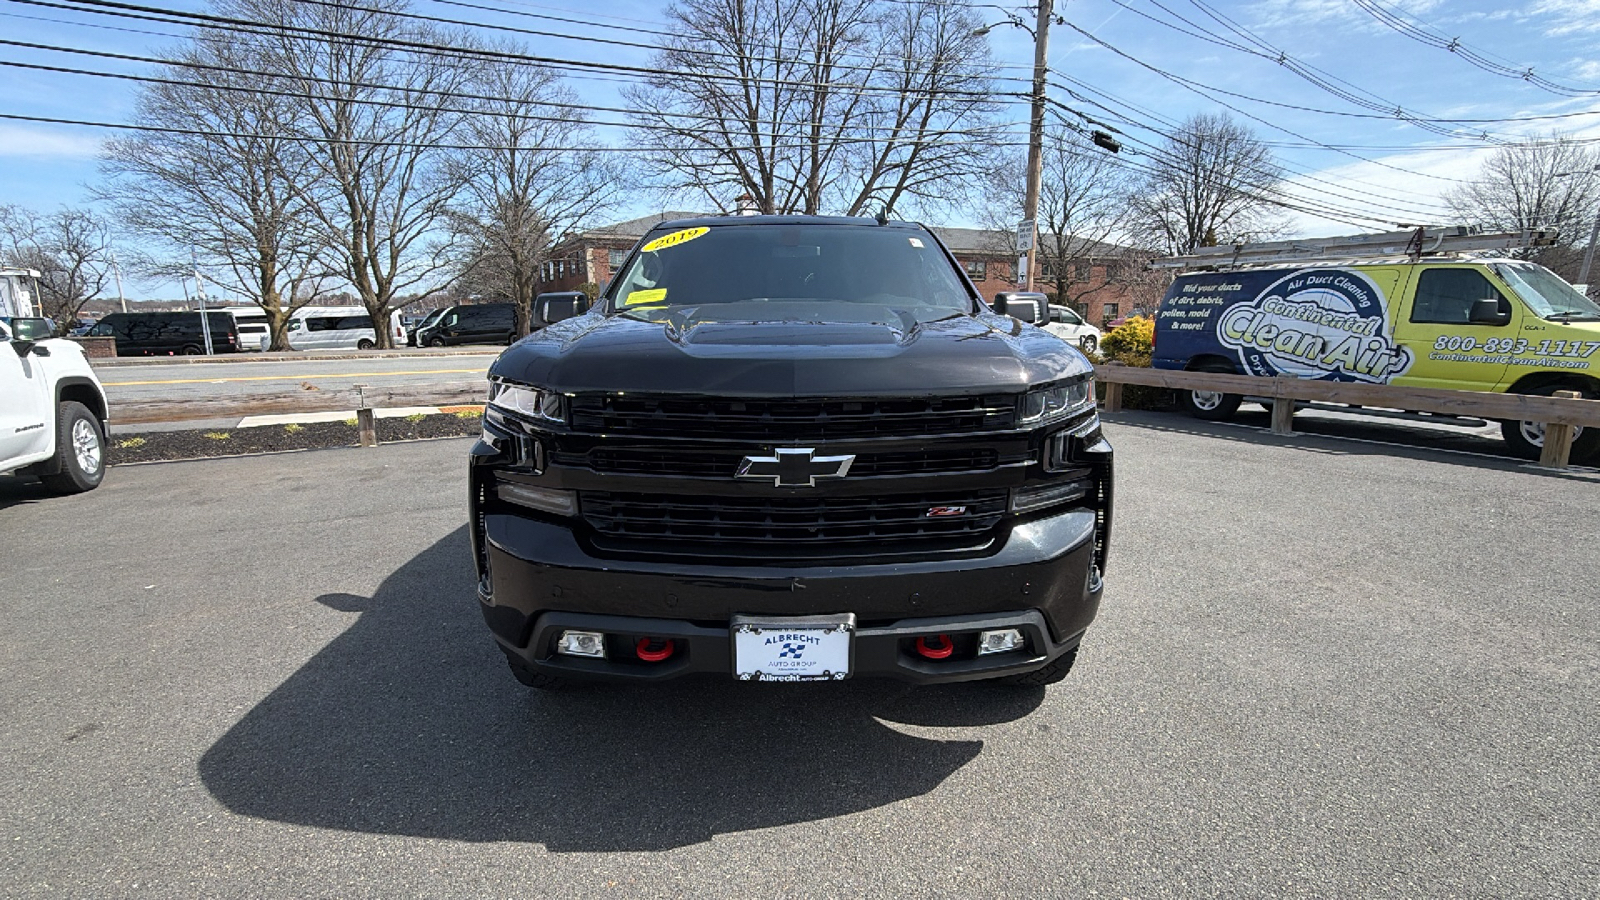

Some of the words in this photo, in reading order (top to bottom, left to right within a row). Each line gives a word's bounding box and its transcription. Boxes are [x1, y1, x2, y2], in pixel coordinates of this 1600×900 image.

[654, 230, 698, 248] 2019
[1183, 284, 1197, 292] Rid
[1196, 284, 1217, 293] your
[1218, 283, 1242, 291] ducts
[1287, 279, 1304, 292] Air
[1307, 276, 1333, 285] Duct
[1334, 276, 1371, 308] Cleaning
[1169, 297, 1178, 305] of
[1178, 296, 1195, 305] dirt,
[1197, 296, 1223, 305] debris,
[1160, 309, 1186, 318] pollen,
[1188, 309, 1211, 317] mold
[1264, 298, 1379, 336] Continental
[1180, 322, 1204, 330] more!
[1225, 310, 1326, 360] Clean
[1322, 336, 1404, 378] Air
[1434, 335, 1600, 358] 800-893-1117
[1428, 351, 1590, 370] ContinentalCleanAir.com
[765, 634, 820, 645] ALBRECHT
